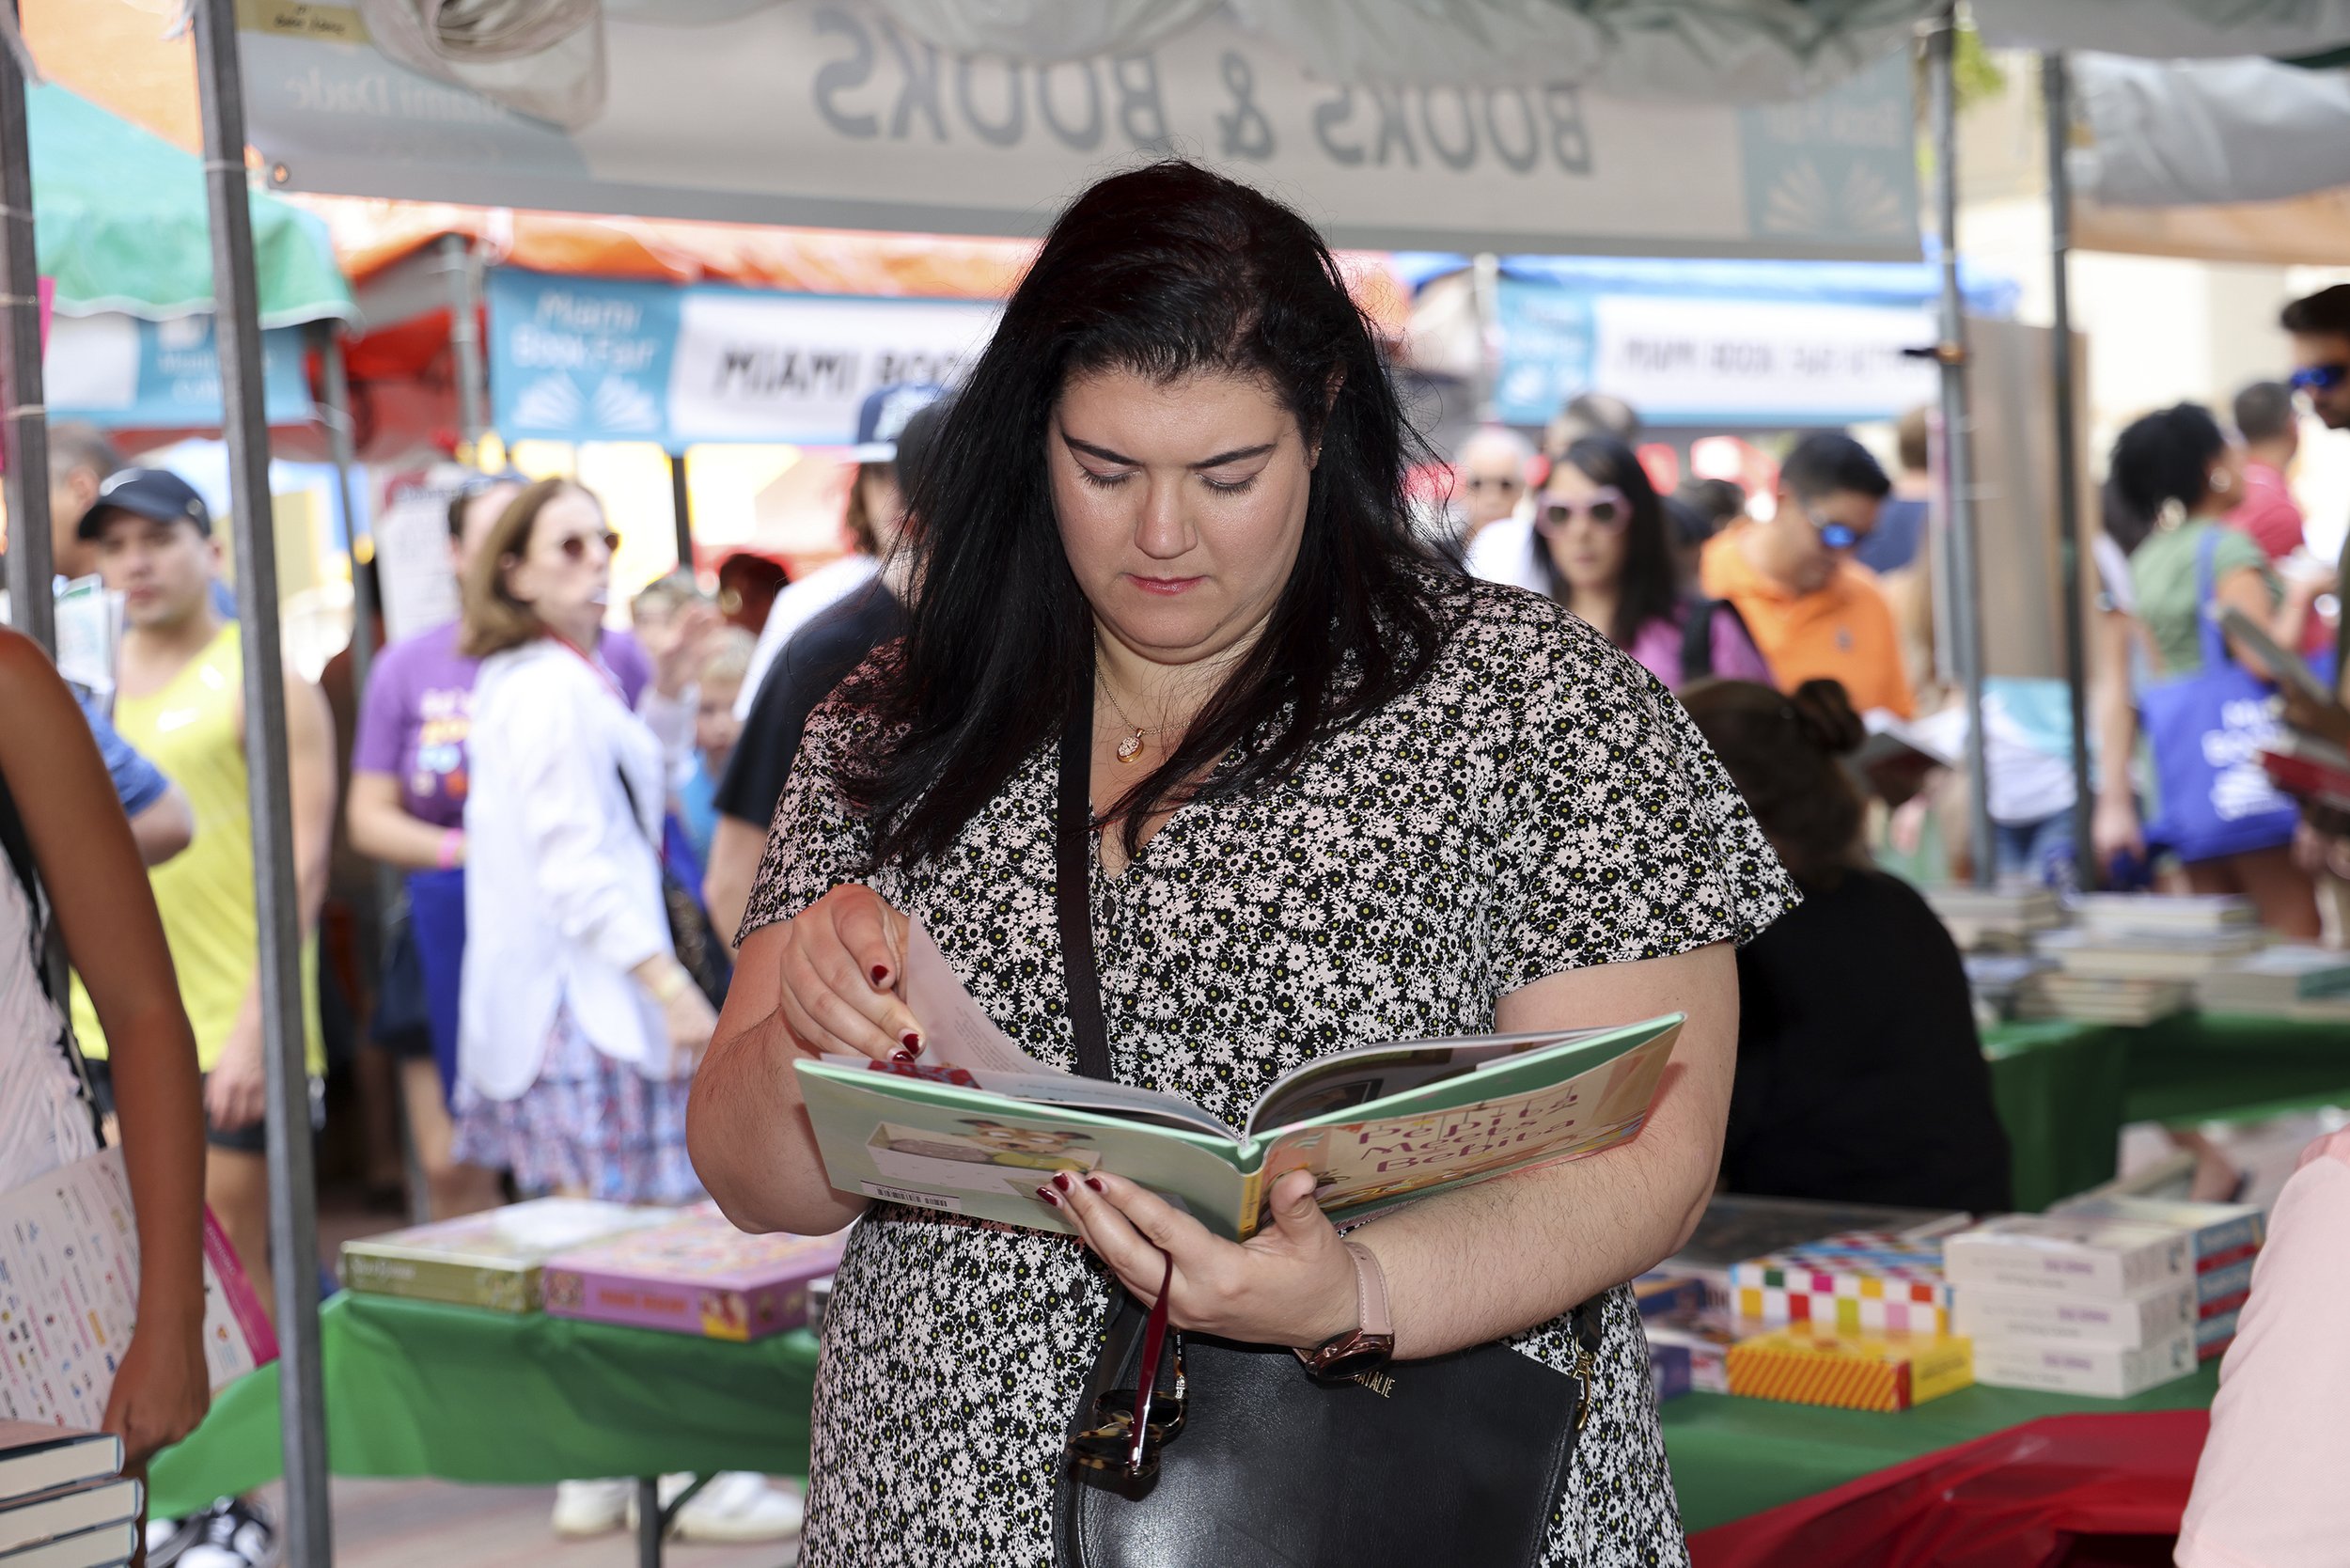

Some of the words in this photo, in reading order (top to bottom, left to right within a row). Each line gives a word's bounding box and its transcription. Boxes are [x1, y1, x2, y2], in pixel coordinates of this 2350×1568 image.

[1358, 1093, 1578, 1144] Pepita
[1361, 1121, 1538, 1160] Meets
[1376, 1120, 1575, 1173] Bebita
